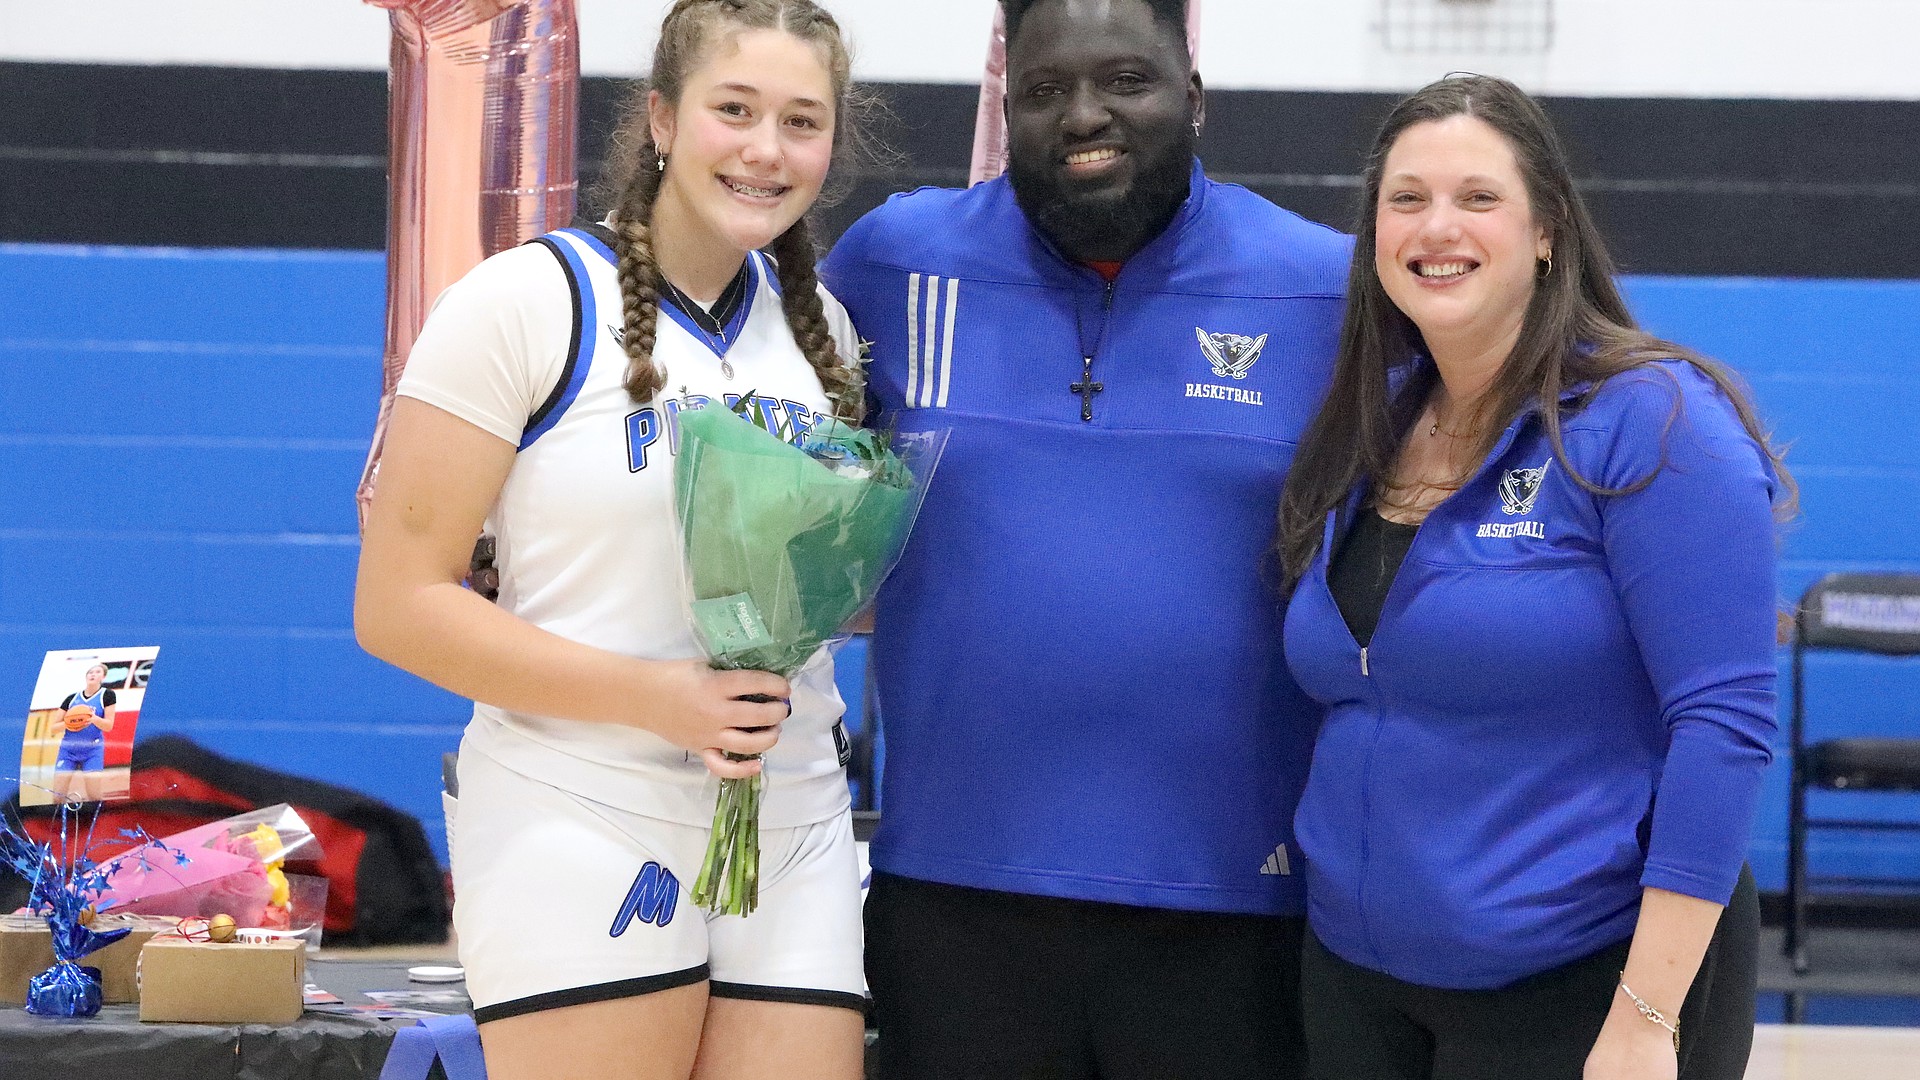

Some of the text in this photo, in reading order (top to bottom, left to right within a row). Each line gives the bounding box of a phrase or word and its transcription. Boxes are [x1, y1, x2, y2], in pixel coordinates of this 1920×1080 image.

[1184, 383, 1263, 406] BASKETBALL
[1475, 521, 1545, 539] BASKETBALL
[609, 861, 680, 938] M
